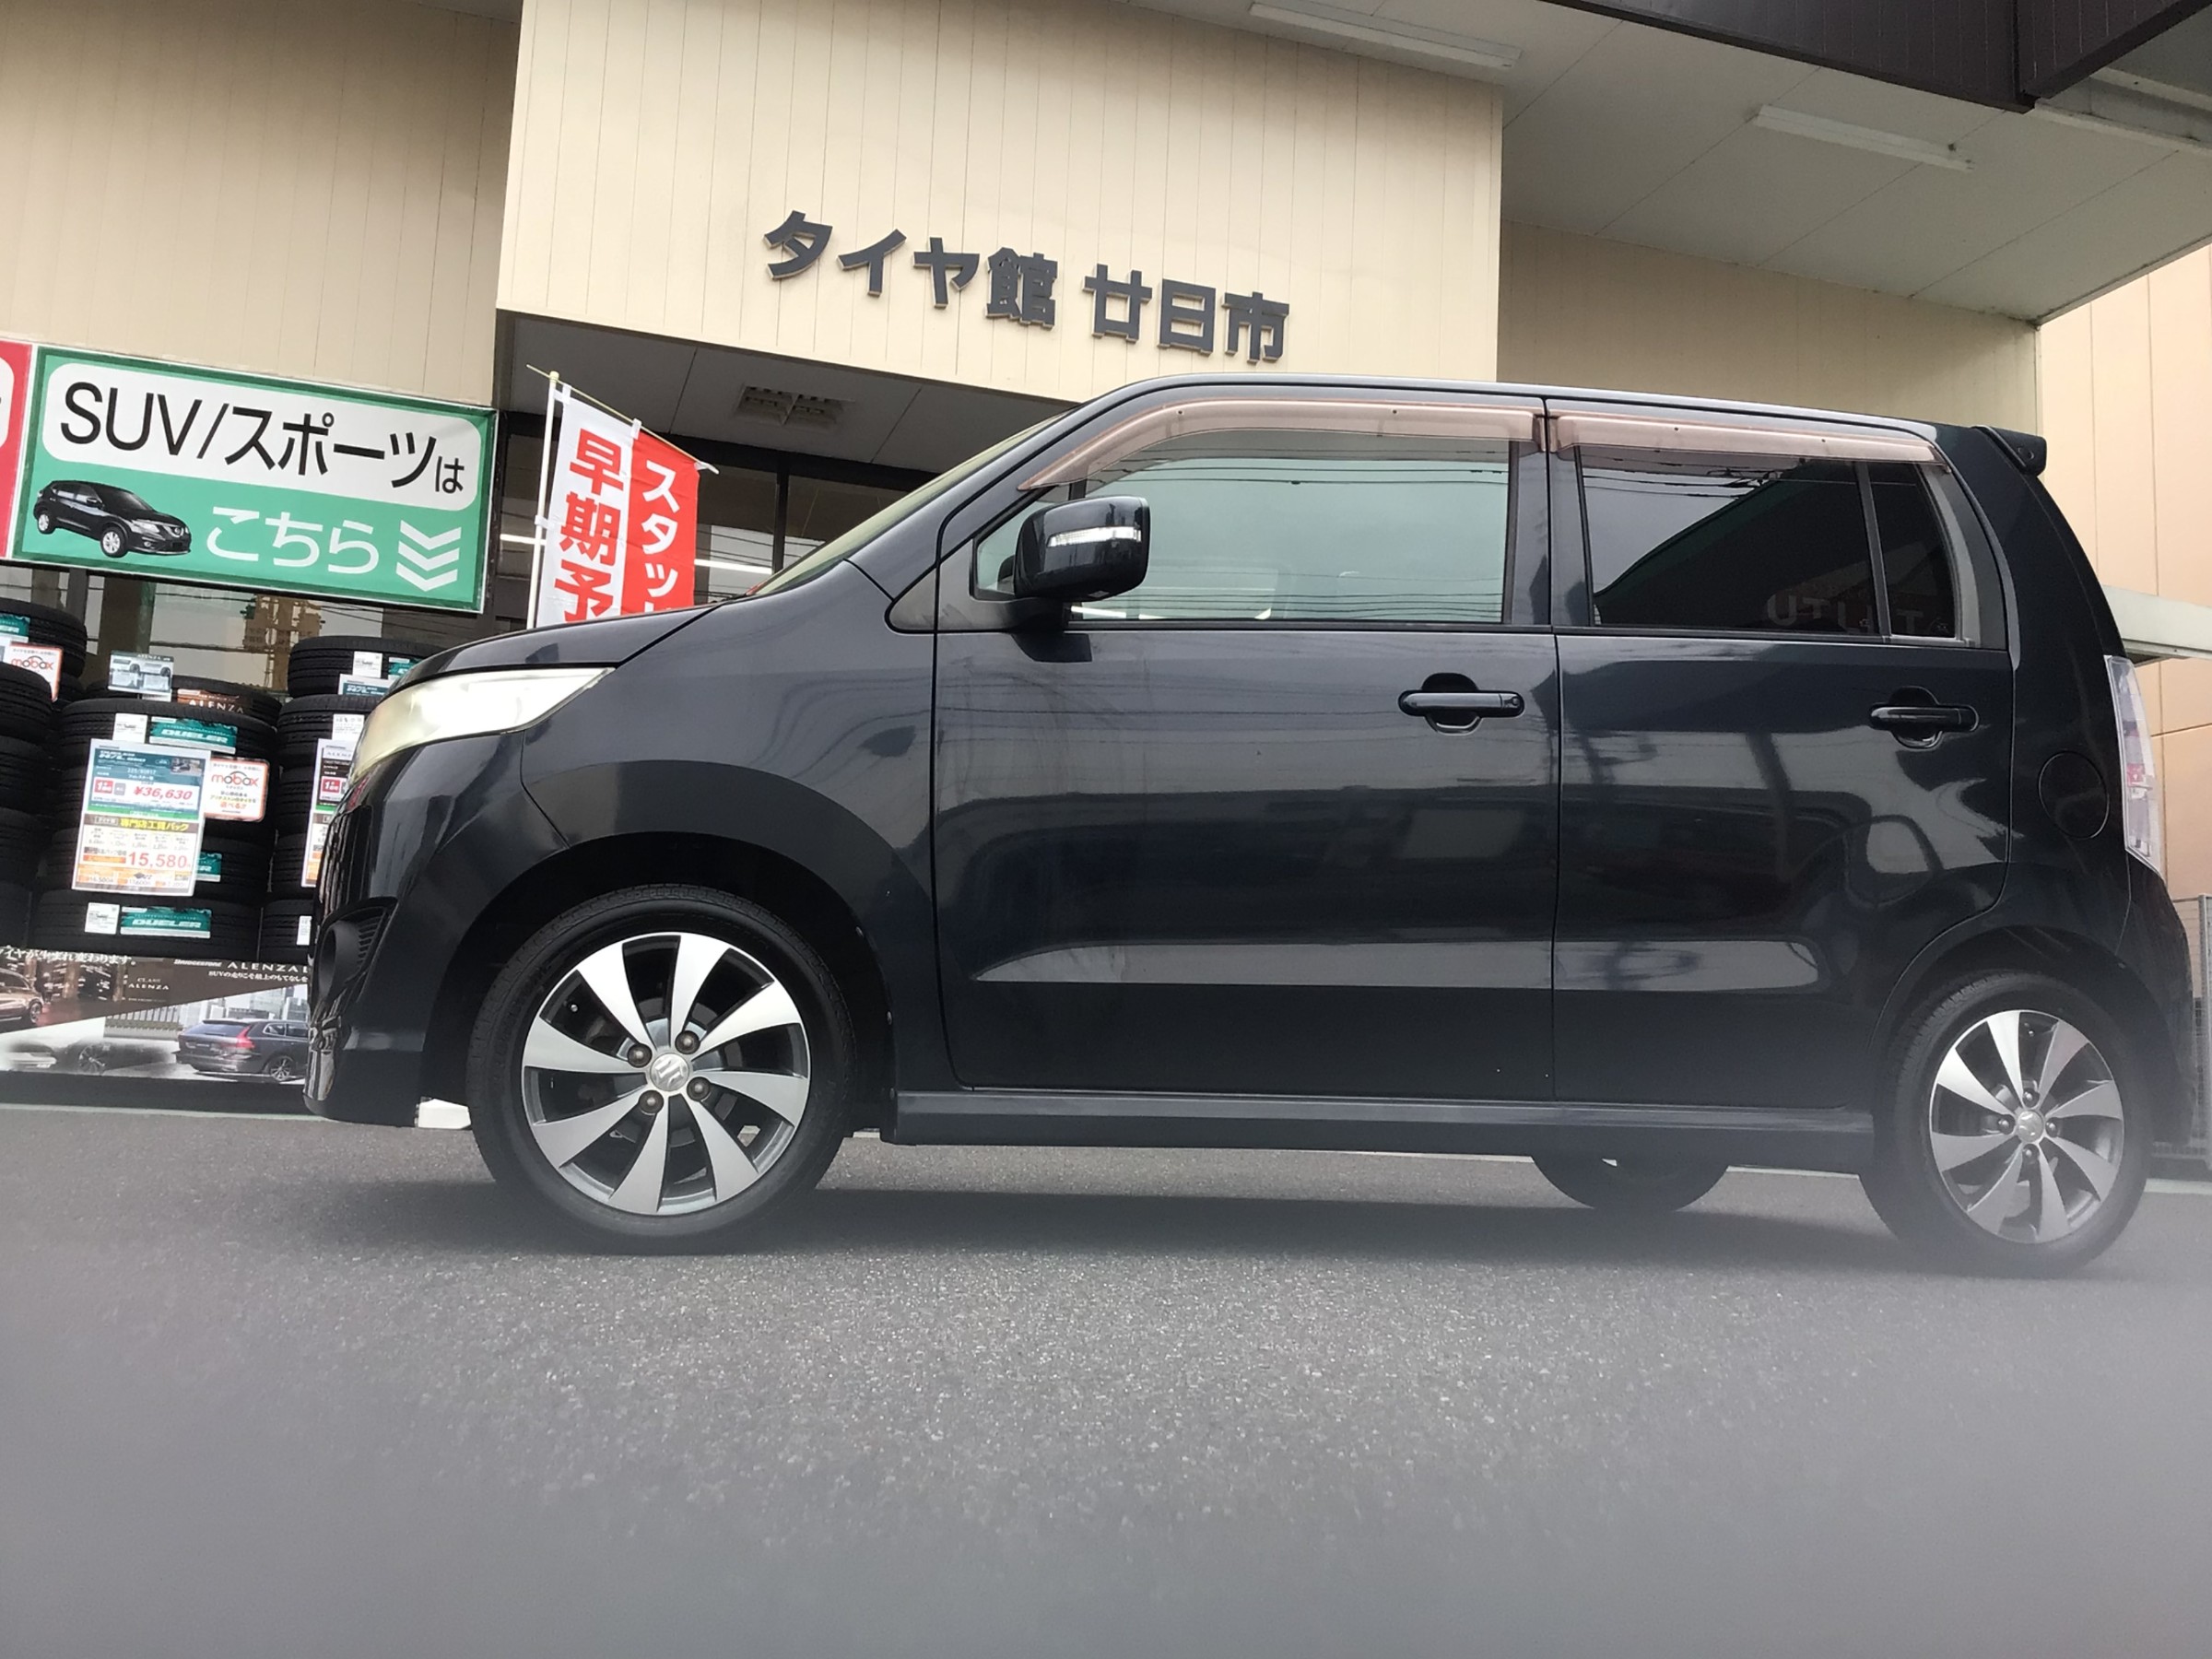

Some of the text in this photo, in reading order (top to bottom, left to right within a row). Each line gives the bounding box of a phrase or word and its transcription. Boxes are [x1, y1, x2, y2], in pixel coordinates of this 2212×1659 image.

[763, 210, 1290, 364] タイヤ館 廿日市
[60, 381, 465, 495] SUV/スポーツは
[206, 506, 380, 575] こちら
[160, 728, 229, 744] DUELER
[211, 771, 260, 786] mobox
[134, 785, 194, 800] ¥36,630
[132, 919, 202, 929] DUELER
[228, 961, 298, 972] ALENZA
